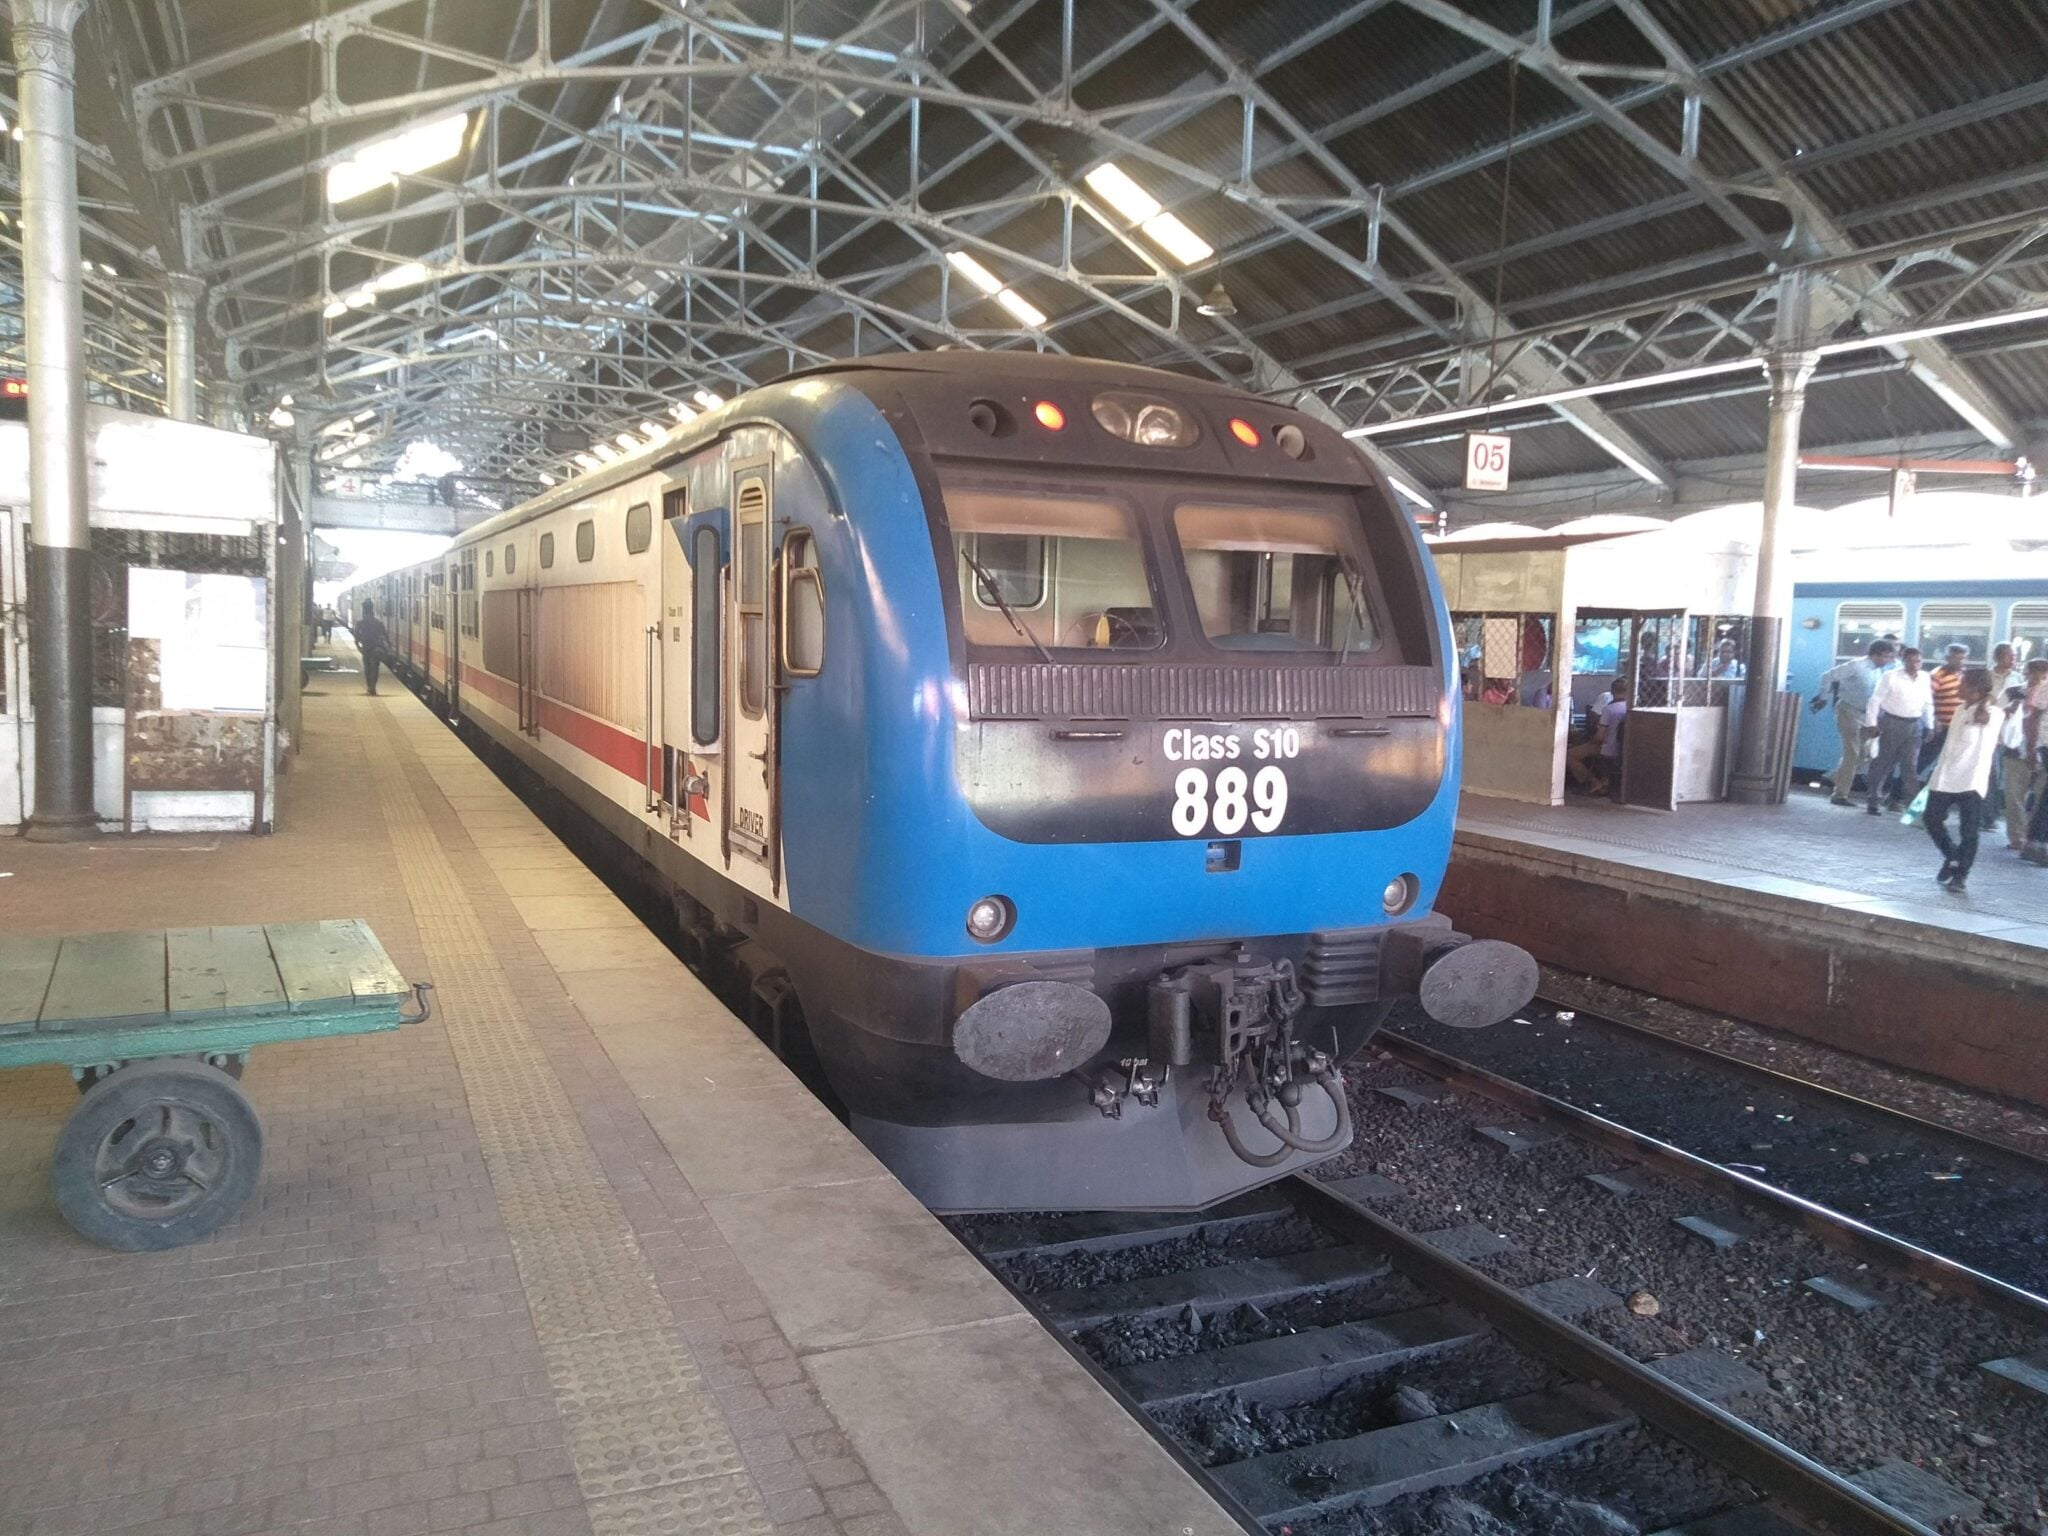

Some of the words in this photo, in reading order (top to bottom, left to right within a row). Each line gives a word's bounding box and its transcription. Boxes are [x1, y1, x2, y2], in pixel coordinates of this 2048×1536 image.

[1474, 442, 1504, 472] 05
[342, 478, 356, 493] 4
[1163, 728, 1241, 761] Class
[1253, 727, 1300, 760] S10
[1171, 765, 1288, 837] 889
[739, 806, 764, 837] DRIVER
